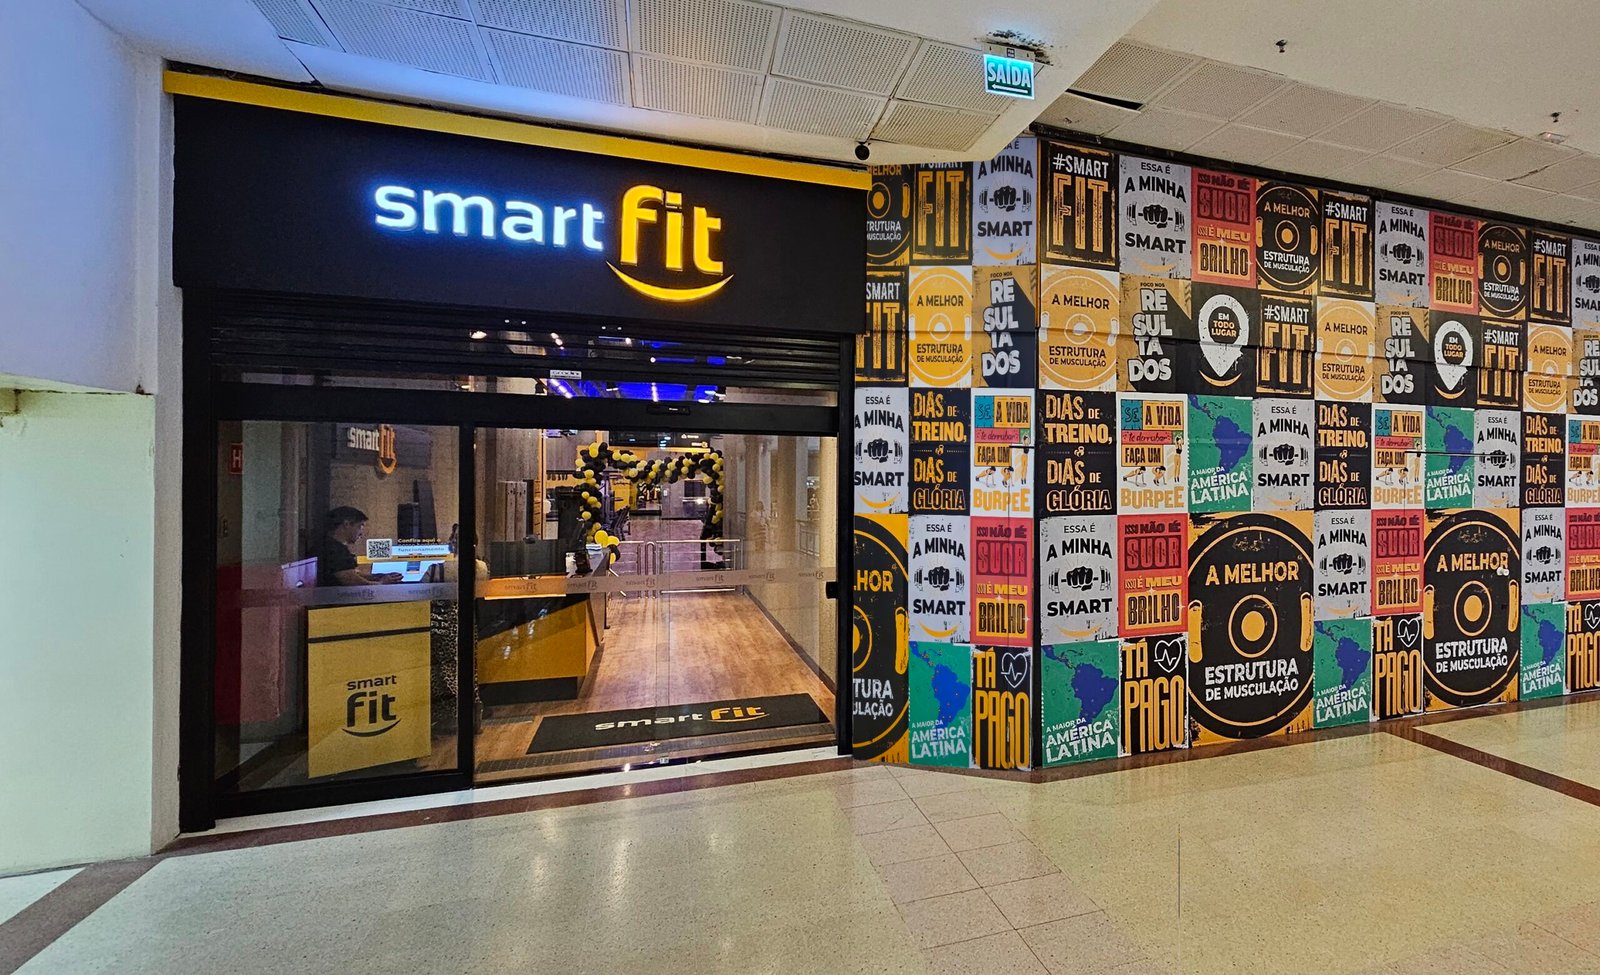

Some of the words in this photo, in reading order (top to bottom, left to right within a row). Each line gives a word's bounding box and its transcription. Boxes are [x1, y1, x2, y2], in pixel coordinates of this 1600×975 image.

[988, 60, 1031, 87] SAÍDA
[978, 161, 987, 180] A
[990, 155, 1034, 179] MINHA
[1052, 153, 1109, 179] #SMART
[1124, 176, 1136, 194] A
[1139, 176, 1186, 203] MINHA
[918, 170, 964, 247] FIT
[1052, 172, 1108, 253] FIT
[1200, 188, 1248, 222] SUOR
[1264, 202, 1272, 212] A
[1274, 202, 1310, 218] MELHOR
[1325, 201, 1368, 222] #SMART
[374, 185, 604, 251] smart
[620, 184, 724, 276] fit
[978, 220, 1032, 238] SMART
[1379, 220, 1387, 234] A
[1390, 219, 1426, 242] MINHA
[1125, 232, 1186, 254] SMART
[1326, 218, 1367, 286] FIT
[1534, 239, 1566, 256] #SMART
[1200, 242, 1248, 276] BRILHO
[1264, 250, 1310, 265] ESTRUTURA
[1379, 268, 1426, 286] SMART
[1484, 282, 1520, 294] ESTRUTURA
[1534, 254, 1566, 313] FIT
[991, 278, 1016, 304] RE
[1140, 288, 1168, 312] RE
[1436, 276, 1472, 304] BRILHO
[1052, 294, 1060, 306] A
[1064, 296, 1110, 310] MELHOR
[984, 306, 1018, 331] SUL
[1133, 313, 1172, 336] SUL
[1213, 320, 1234, 329] TODO
[1218, 312, 1230, 321] EM
[1264, 305, 1309, 324] #SMART
[1212, 328, 1236, 338] LUGAR
[1391, 316, 1412, 336] RE
[916, 344, 964, 354] ESTRUTURA
[1136, 336, 1164, 356] TA
[1386, 338, 1415, 358] SUL
[1484, 330, 1518, 346] #SMART
[982, 350, 1020, 377] DOS
[1049, 346, 1106, 360] ESTRUTURA
[1050, 358, 1058, 366] DE
[1059, 358, 1106, 368] MUSCULAÇÃO
[1262, 322, 1308, 384] FIT
[1128, 358, 1172, 382] DOS
[1322, 363, 1365, 374] ESTRUTURA
[1382, 374, 1414, 394] DOS
[866, 396, 884, 405] ESSA
[886, 395, 890, 404] É
[914, 391, 944, 418] DIAS
[947, 406, 958, 416] DE
[1046, 394, 1084, 420] DIAS
[1088, 408, 1100, 419] DE
[1124, 407, 1140, 422] SE
[1145, 406, 1152, 426] A
[1156, 406, 1182, 426] VIDA
[1320, 404, 1348, 428] DIAS
[1350, 417, 1360, 426] DE
[1526, 415, 1548, 436] DIAS
[1550, 426, 1557, 434] DE
[912, 421, 968, 442] TREINO,
[1044, 422, 1112, 444] TREINO,
[1258, 422, 1266, 438] A
[1270, 419, 1310, 439] MINHA
[1318, 430, 1368, 448] TREINO,
[347, 428, 380, 450] smart
[380, 424, 396, 460] fit
[1526, 438, 1564, 454] TREINO,
[1125, 447, 1146, 465] FAÇA
[1148, 448, 1161, 462] UM
[854, 472, 904, 486] SMART
[914, 456, 944, 484] DIAS
[947, 472, 958, 482] DE
[1047, 458, 1085, 485] DIAS
[1089, 472, 1102, 483] DE
[1191, 471, 1248, 490] AMÉRICA
[1258, 474, 1310, 486] SMART
[914, 484, 966, 510] GLÓRIA
[973, 488, 1031, 512] BURPEE
[1046, 486, 1112, 512] GLÓRIA
[1120, 486, 1184, 508] BURPEE
[1191, 483, 1249, 504] LATINA
[1320, 483, 1368, 506] GLÓRIA
[1064, 526, 1086, 534] ESSA
[1090, 523, 1096, 532] É
[1140, 521, 1166, 534] NÃO
[1168, 520, 1180, 532] É
[1525, 529, 1532, 542] A
[1534, 524, 1562, 540] MINHA
[912, 542, 922, 559] A
[924, 538, 966, 560] MINHA
[1046, 544, 1058, 562] A
[1062, 538, 1112, 559] MINHA
[1318, 534, 1326, 549] A
[1330, 529, 1367, 547] MINHA
[1378, 530, 1419, 556] SUOR
[978, 542, 1025, 574] SUOR
[1127, 538, 1180, 568] SUOR
[1437, 554, 1448, 572] A
[1452, 552, 1508, 571] MELHOR
[1138, 576, 1144, 588] É
[1146, 576, 1182, 588] MEU
[1205, 564, 1220, 586] A
[1224, 561, 1300, 584] MELHOR
[1525, 570, 1561, 584] SMART
[1318, 582, 1367, 596] SMART
[1378, 578, 1418, 606] BRILHO
[913, 599, 966, 616] SMART
[978, 602, 1026, 634] BRILHO
[1047, 598, 1112, 617] SMART
[1128, 593, 1180, 625] BRILHO
[1568, 602, 1582, 632] TÁ
[1374, 616, 1393, 652] TÁ
[1122, 638, 1148, 678] TÁ
[1436, 637, 1508, 659] ESTRUTURA
[973, 646, 996, 688] TÁ
[1205, 658, 1298, 686] ESTRUTURA
[1436, 662, 1448, 673] DE
[1450, 654, 1508, 672] MUSCULAÇÃO
[1523, 662, 1561, 682] AMÉRICA
[346, 674, 396, 690] smart
[1206, 688, 1222, 701] DE
[1224, 676, 1298, 700] MUSCULAÇÃO
[1375, 650, 1422, 719] PAGO
[1524, 673, 1562, 694] LATINA
[346, 690, 396, 728] fit
[1316, 686, 1366, 710] AMÉRICA
[594, 712, 703, 732] smart
[710, 704, 766, 720] fit
[1124, 675, 1184, 752] PAGO
[1316, 698, 1368, 723] LATINA
[912, 725, 966, 744] AMÉRICA
[975, 690, 1030, 769] PAGO
[1046, 719, 1114, 748] AMÉRICA
[1053, 720, 1075, 731] MAIOR
[912, 738, 967, 758] LATINA
[1046, 732, 1114, 763] LATINA
